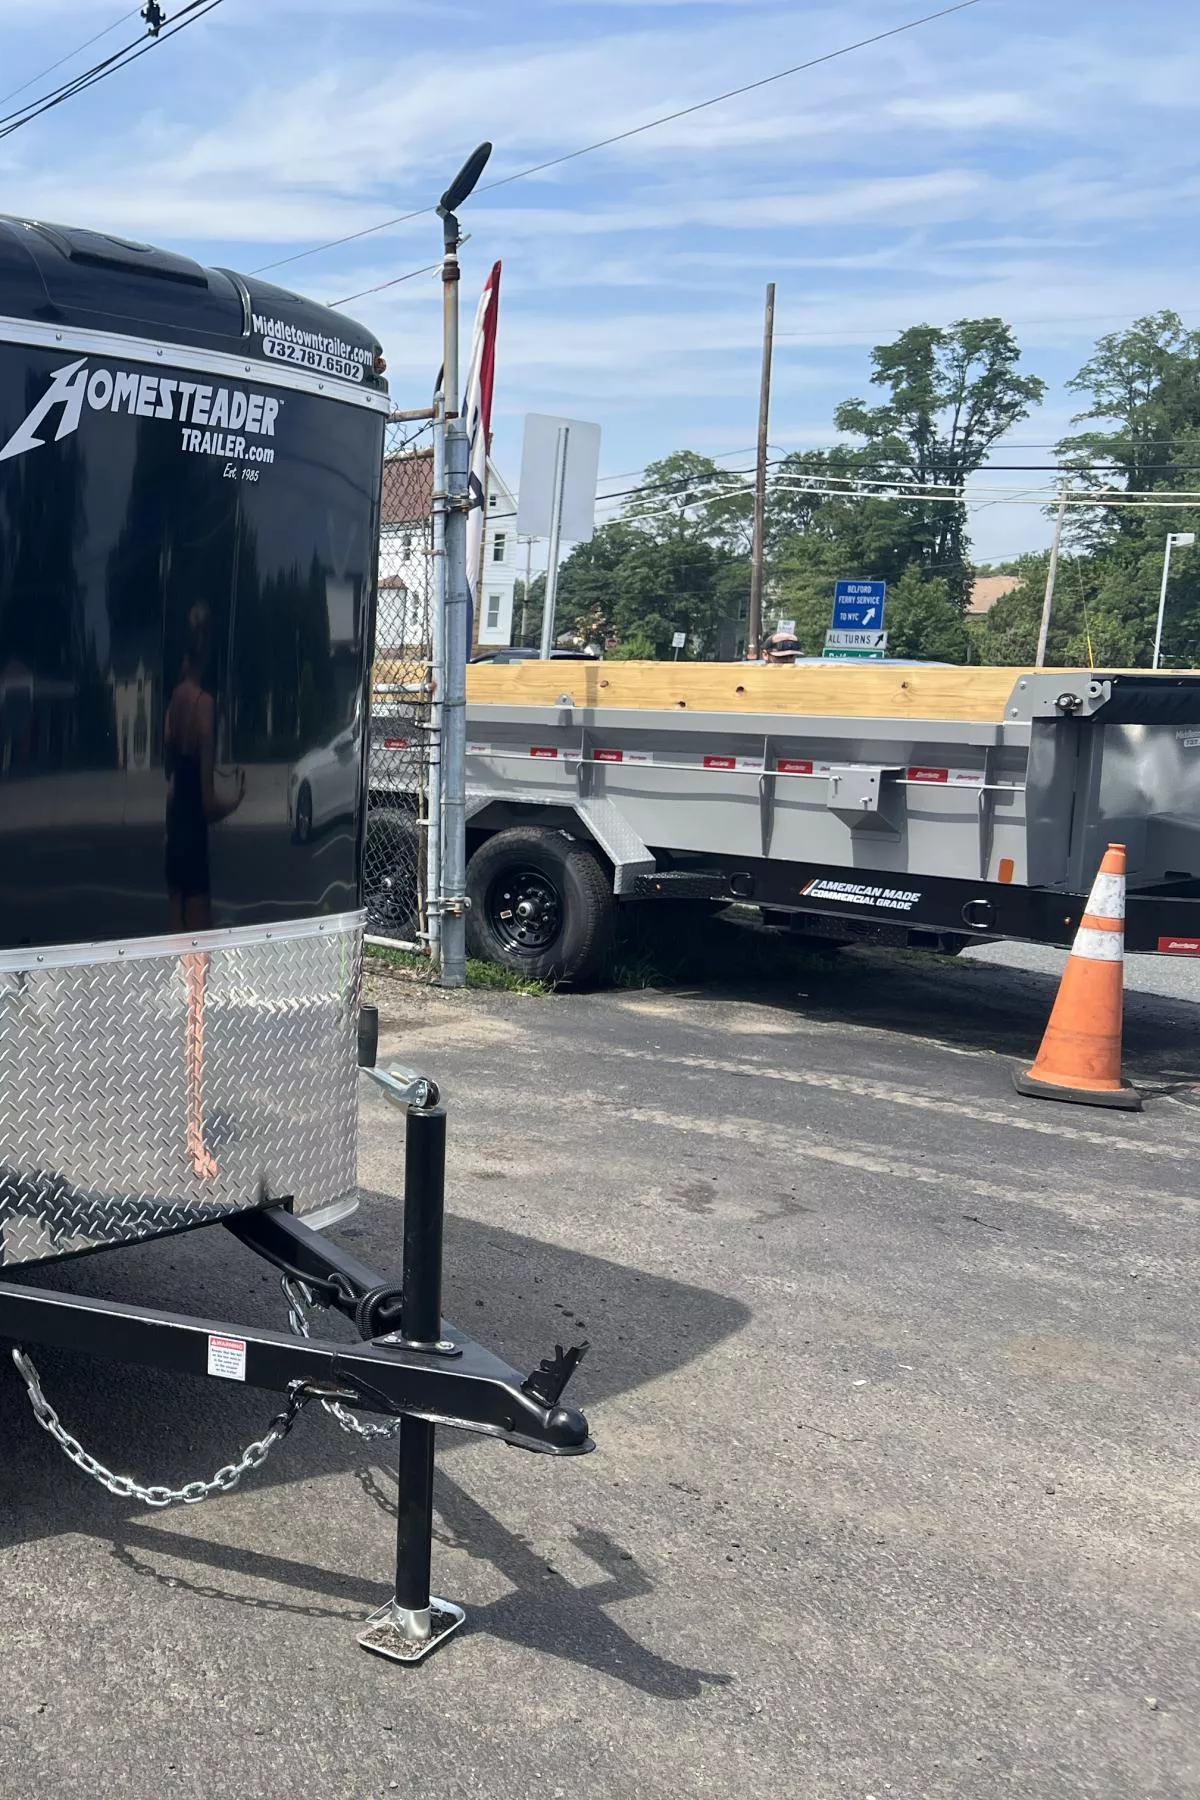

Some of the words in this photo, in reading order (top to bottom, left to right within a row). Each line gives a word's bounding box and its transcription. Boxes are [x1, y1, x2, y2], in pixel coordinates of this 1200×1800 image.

[252, 314, 373, 366] Middletowntrailer.com
[267, 340, 360, 379] 732.787.6502
[181, 428, 274, 464] TRAILER.com
[223, 462, 238, 480] Est.
[241, 469, 259, 482] 1985
[847, 585, 872, 594] BELFORD
[838, 595, 856, 605] FERRY
[856, 596, 880, 605] SERVICE
[840, 612, 847, 621] TO
[847, 612, 860, 621] NYC
[828, 634, 841, 644] ALL
[845, 634, 871, 645] TURNS
[810, 889, 875, 906] COMMERCIAL
[875, 898, 913, 910] GRADE
[818, 880, 882, 897] AMERICAN
[882, 888, 921, 902] MADE
